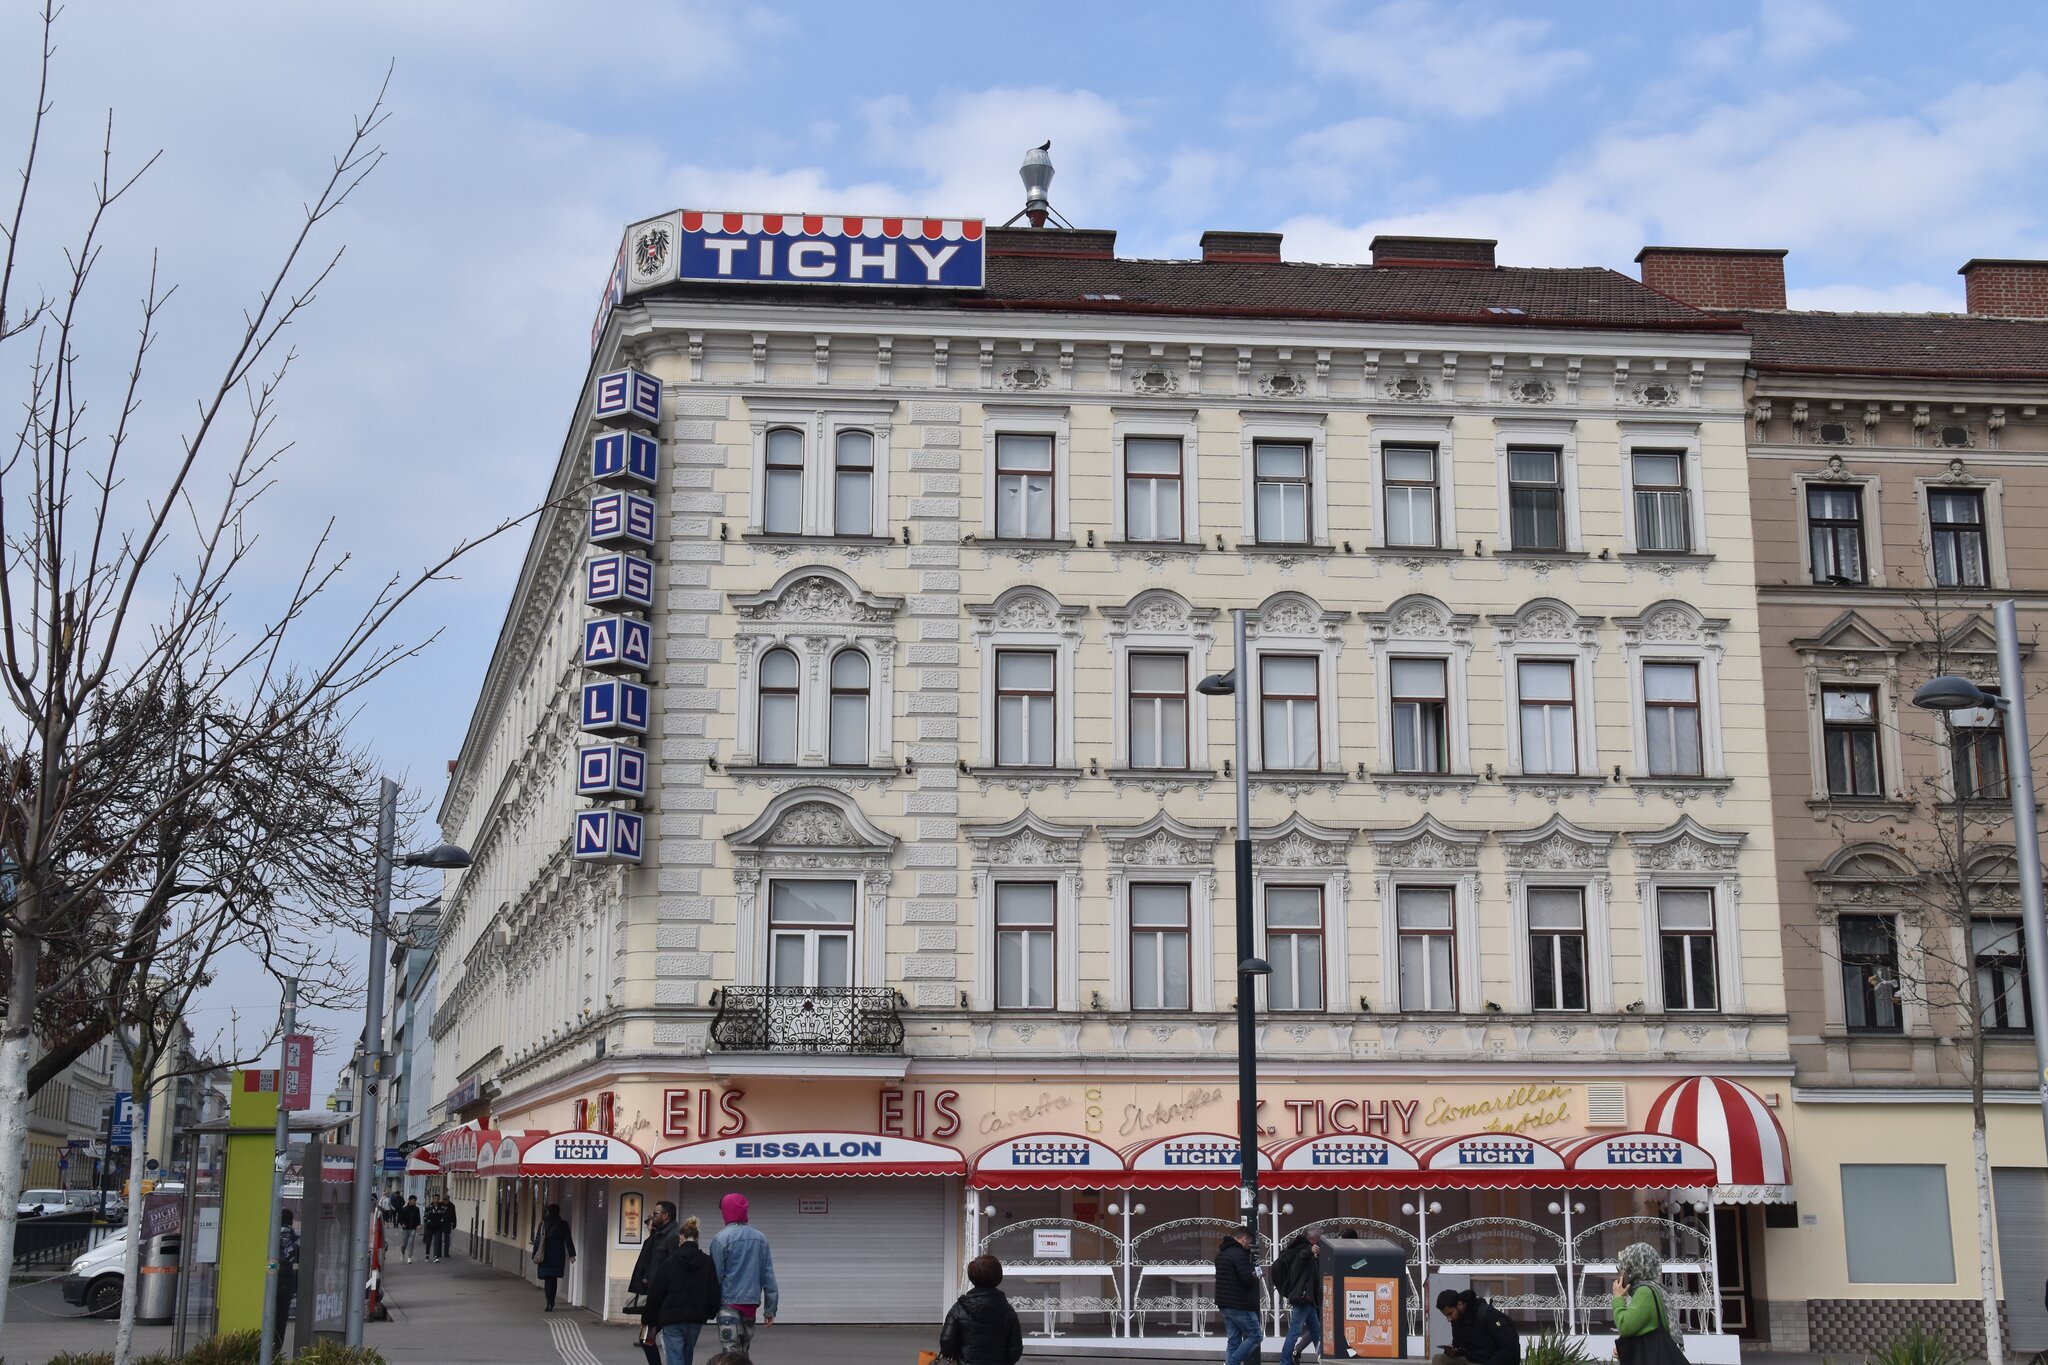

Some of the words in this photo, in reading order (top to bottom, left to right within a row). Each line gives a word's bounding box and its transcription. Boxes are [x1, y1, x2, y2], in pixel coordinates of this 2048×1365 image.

[704, 238, 961, 281] TICHY
[581, 377, 623, 849] EISSALON
[617, 379, 657, 851] EISSALON
[664, 1089, 746, 1137] EIS
[880, 1090, 961, 1138] EIS
[1285, 1099, 1419, 1136] TICHY
[557, 1147, 605, 1158] TICHY
[735, 1142, 881, 1158] EISSALON
[1462, 1151, 1530, 1163] TICHY
[1611, 1151, 1678, 1163] TICHY
[1016, 1152, 1085, 1164] TICHY
[1168, 1152, 1236, 1164] TICHY
[1316, 1152, 1384, 1164] TICHY
[1747, 1187, 1759, 1198] de
